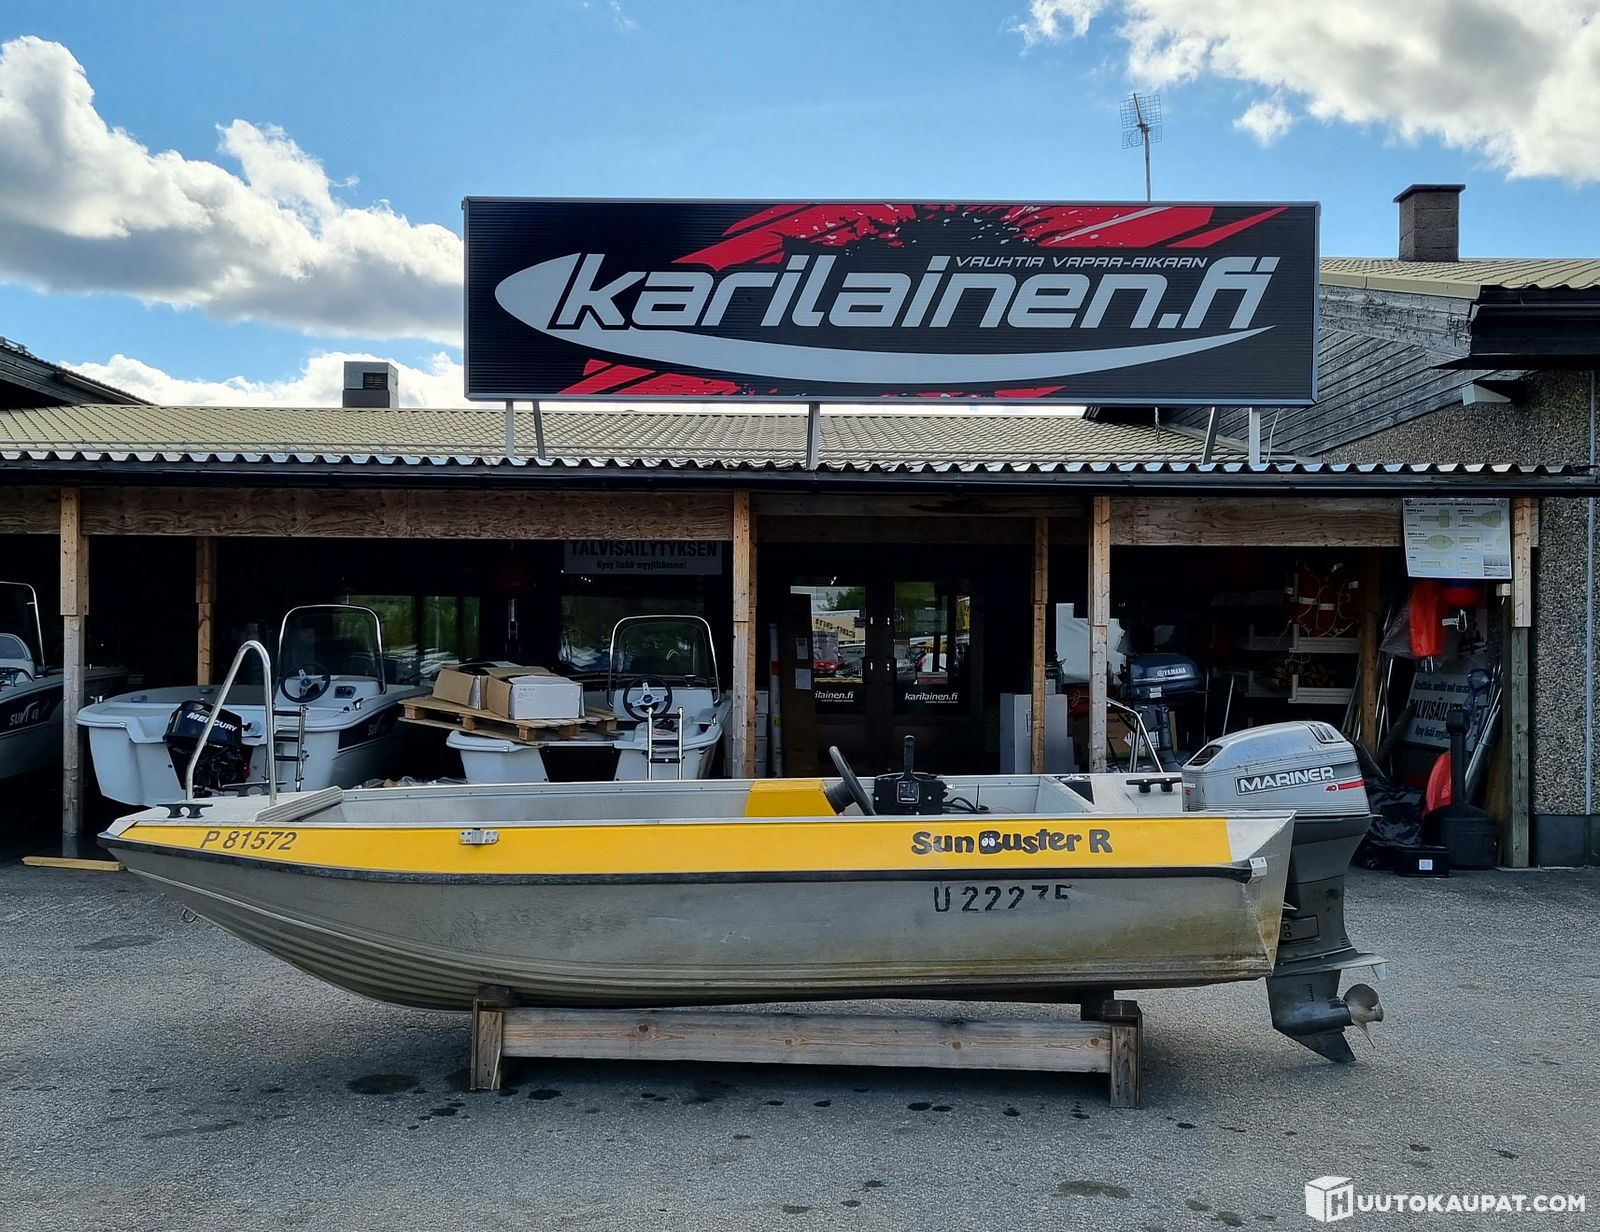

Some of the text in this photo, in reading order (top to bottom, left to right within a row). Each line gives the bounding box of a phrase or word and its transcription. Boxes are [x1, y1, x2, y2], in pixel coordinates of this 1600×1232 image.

[956, 256, 1208, 268] VAUHTIA VAPAA-AIKAAN
[555, 253, 1281, 329] karilainen.fi
[1163, 667, 1187, 676] YAMAHA
[904, 692, 959, 701] karilainen.fi
[1239, 767, 1335, 792] MARINER
[200, 831, 297, 850] P 81572
[911, 828, 1114, 855] Sun Buster R
[933, 885, 951, 912] U
